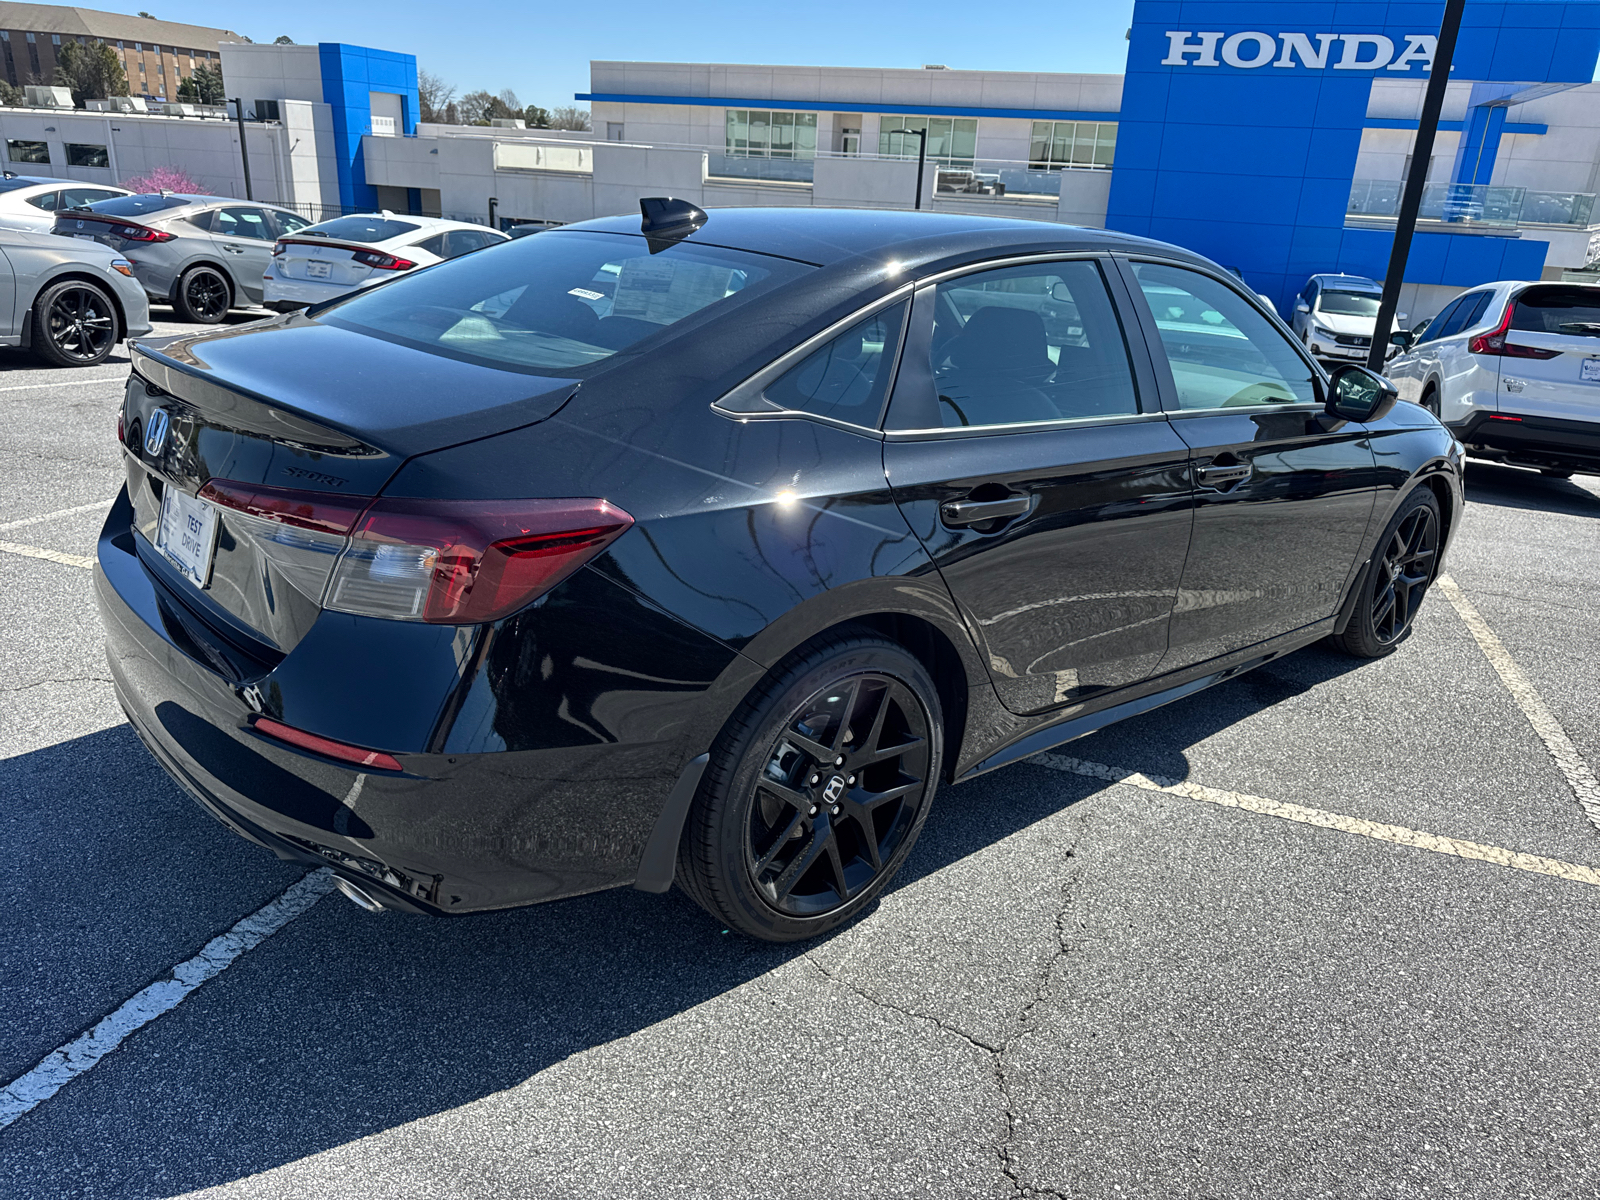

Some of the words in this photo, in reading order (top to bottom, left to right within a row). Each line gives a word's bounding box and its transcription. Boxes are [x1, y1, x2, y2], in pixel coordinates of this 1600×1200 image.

[1161, 31, 1454, 71] HONDA
[280, 466, 350, 487] SPORT
[187, 514, 203, 536] TEST
[181, 532, 202, 558] DRIVE
